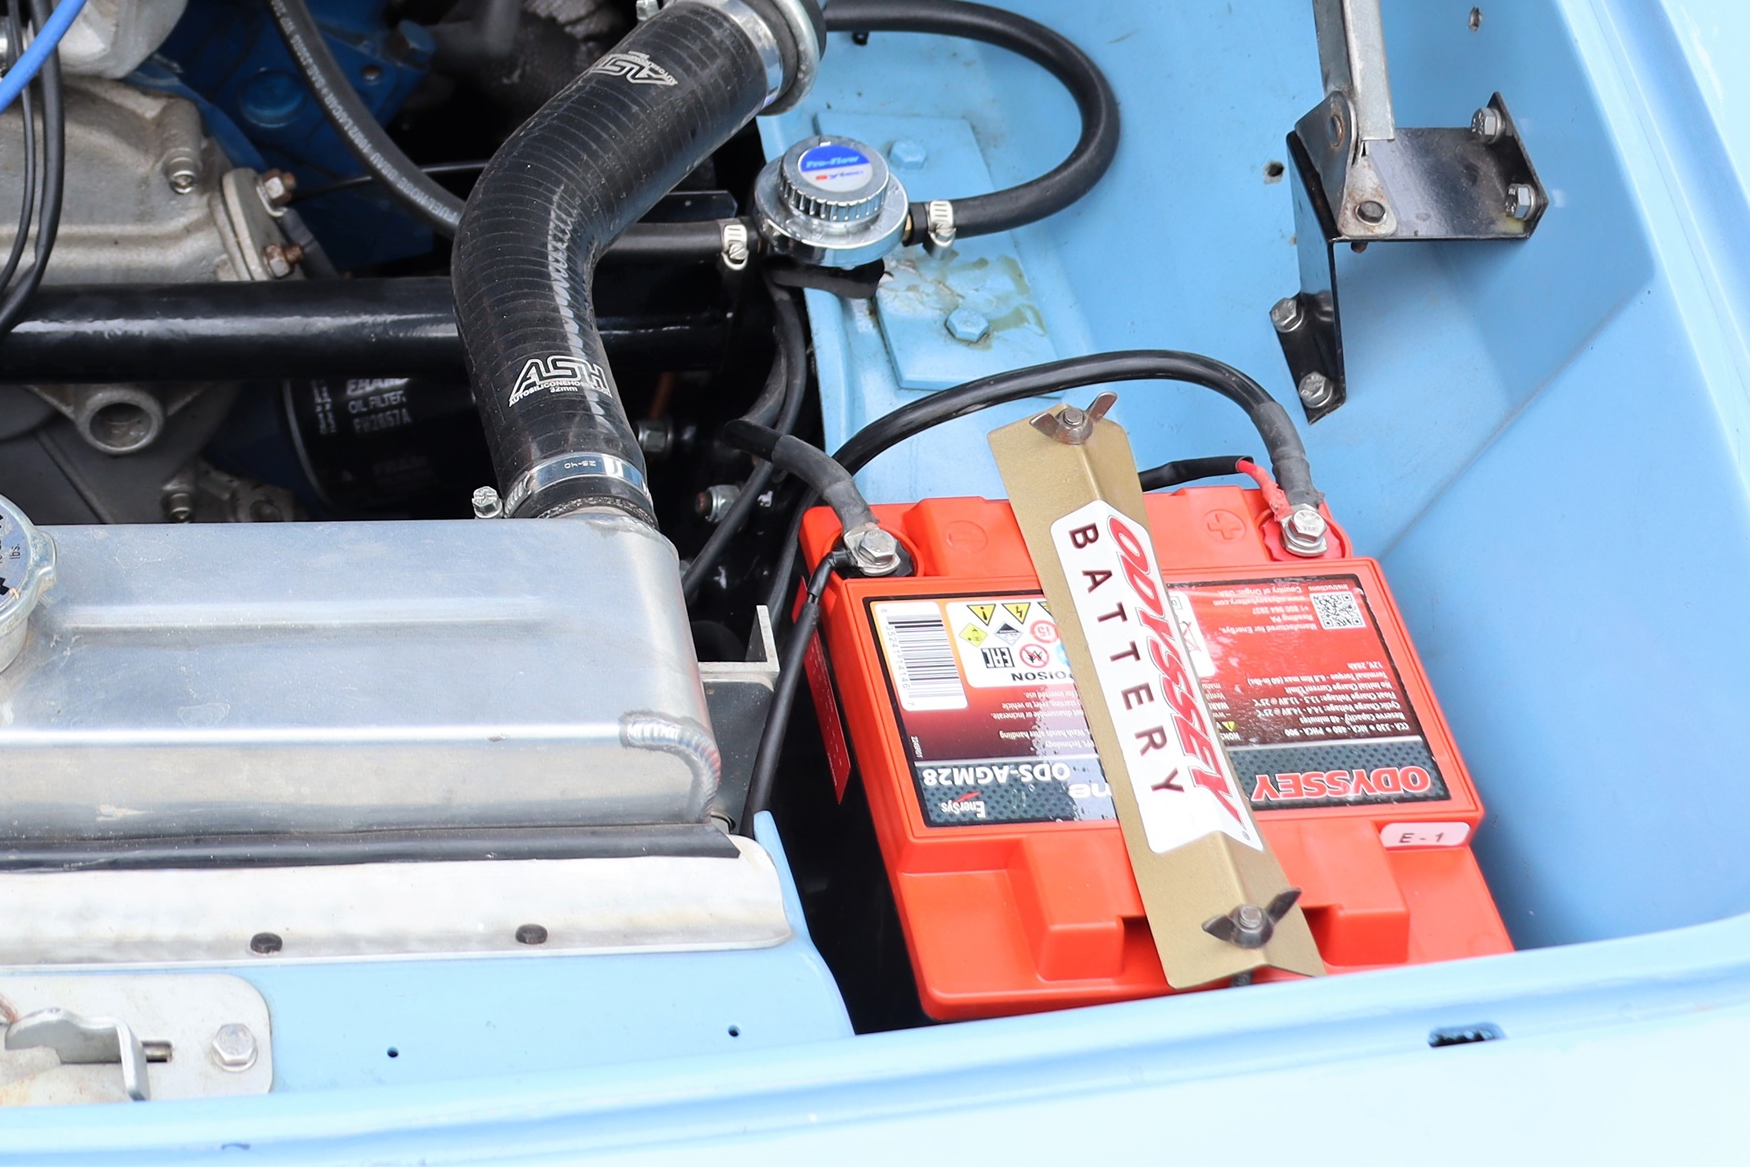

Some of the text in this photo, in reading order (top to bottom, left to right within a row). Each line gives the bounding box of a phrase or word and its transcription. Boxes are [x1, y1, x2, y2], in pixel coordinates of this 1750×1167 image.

[1271, 585, 1302, 593] Country
[1307, 583, 1348, 591] Instructions
[1217, 589, 1234, 597] USA
[1268, 612, 1313, 622] Reading PA
[1253, 624, 1265, 632] for
[1264, 621, 1318, 631] Manufactured
[1068, 522, 1185, 794] BATTERY
[1107, 514, 1244, 824] ODYSSEY
[1009, 669, 1072, 681] OISON
[1283, 674, 1299, 683] max
[1329, 671, 1356, 680] Torque
[1355, 670, 1388, 679] Terminal
[1304, 683, 1332, 693] Current
[1331, 681, 1357, 691] Charge
[1356, 681, 1379, 690] Initial
[1378, 680, 1392, 689] No
[1319, 692, 1351, 702] Voltage:
[1352, 691, 1376, 700] Charge
[1376, 690, 1396, 699] Float
[1001, 702, 1025, 710] vehicle
[1322, 702, 1354, 712] Voltage:
[1353, 701, 1379, 711] Charge
[1379, 699, 1400, 709] Cyclic
[990, 711, 1025, 719] incinerate.
[1032, 709, 1071, 718] disassemble
[1343, 712, 1375, 723] Capacity
[1375, 710, 1405, 720] Reserve
[1298, 715, 1329, 724] minutes
[1393, 721, 1409, 730] CCA
[998, 729, 1029, 739] handling
[1301, 726, 1323, 736] PHCA
[1044, 739, 1081, 749] Technology
[920, 762, 1071, 786] ODS-AGM28
[1250, 765, 1430, 801] ODYSSEY
[939, 799, 986, 818] EnerSys
